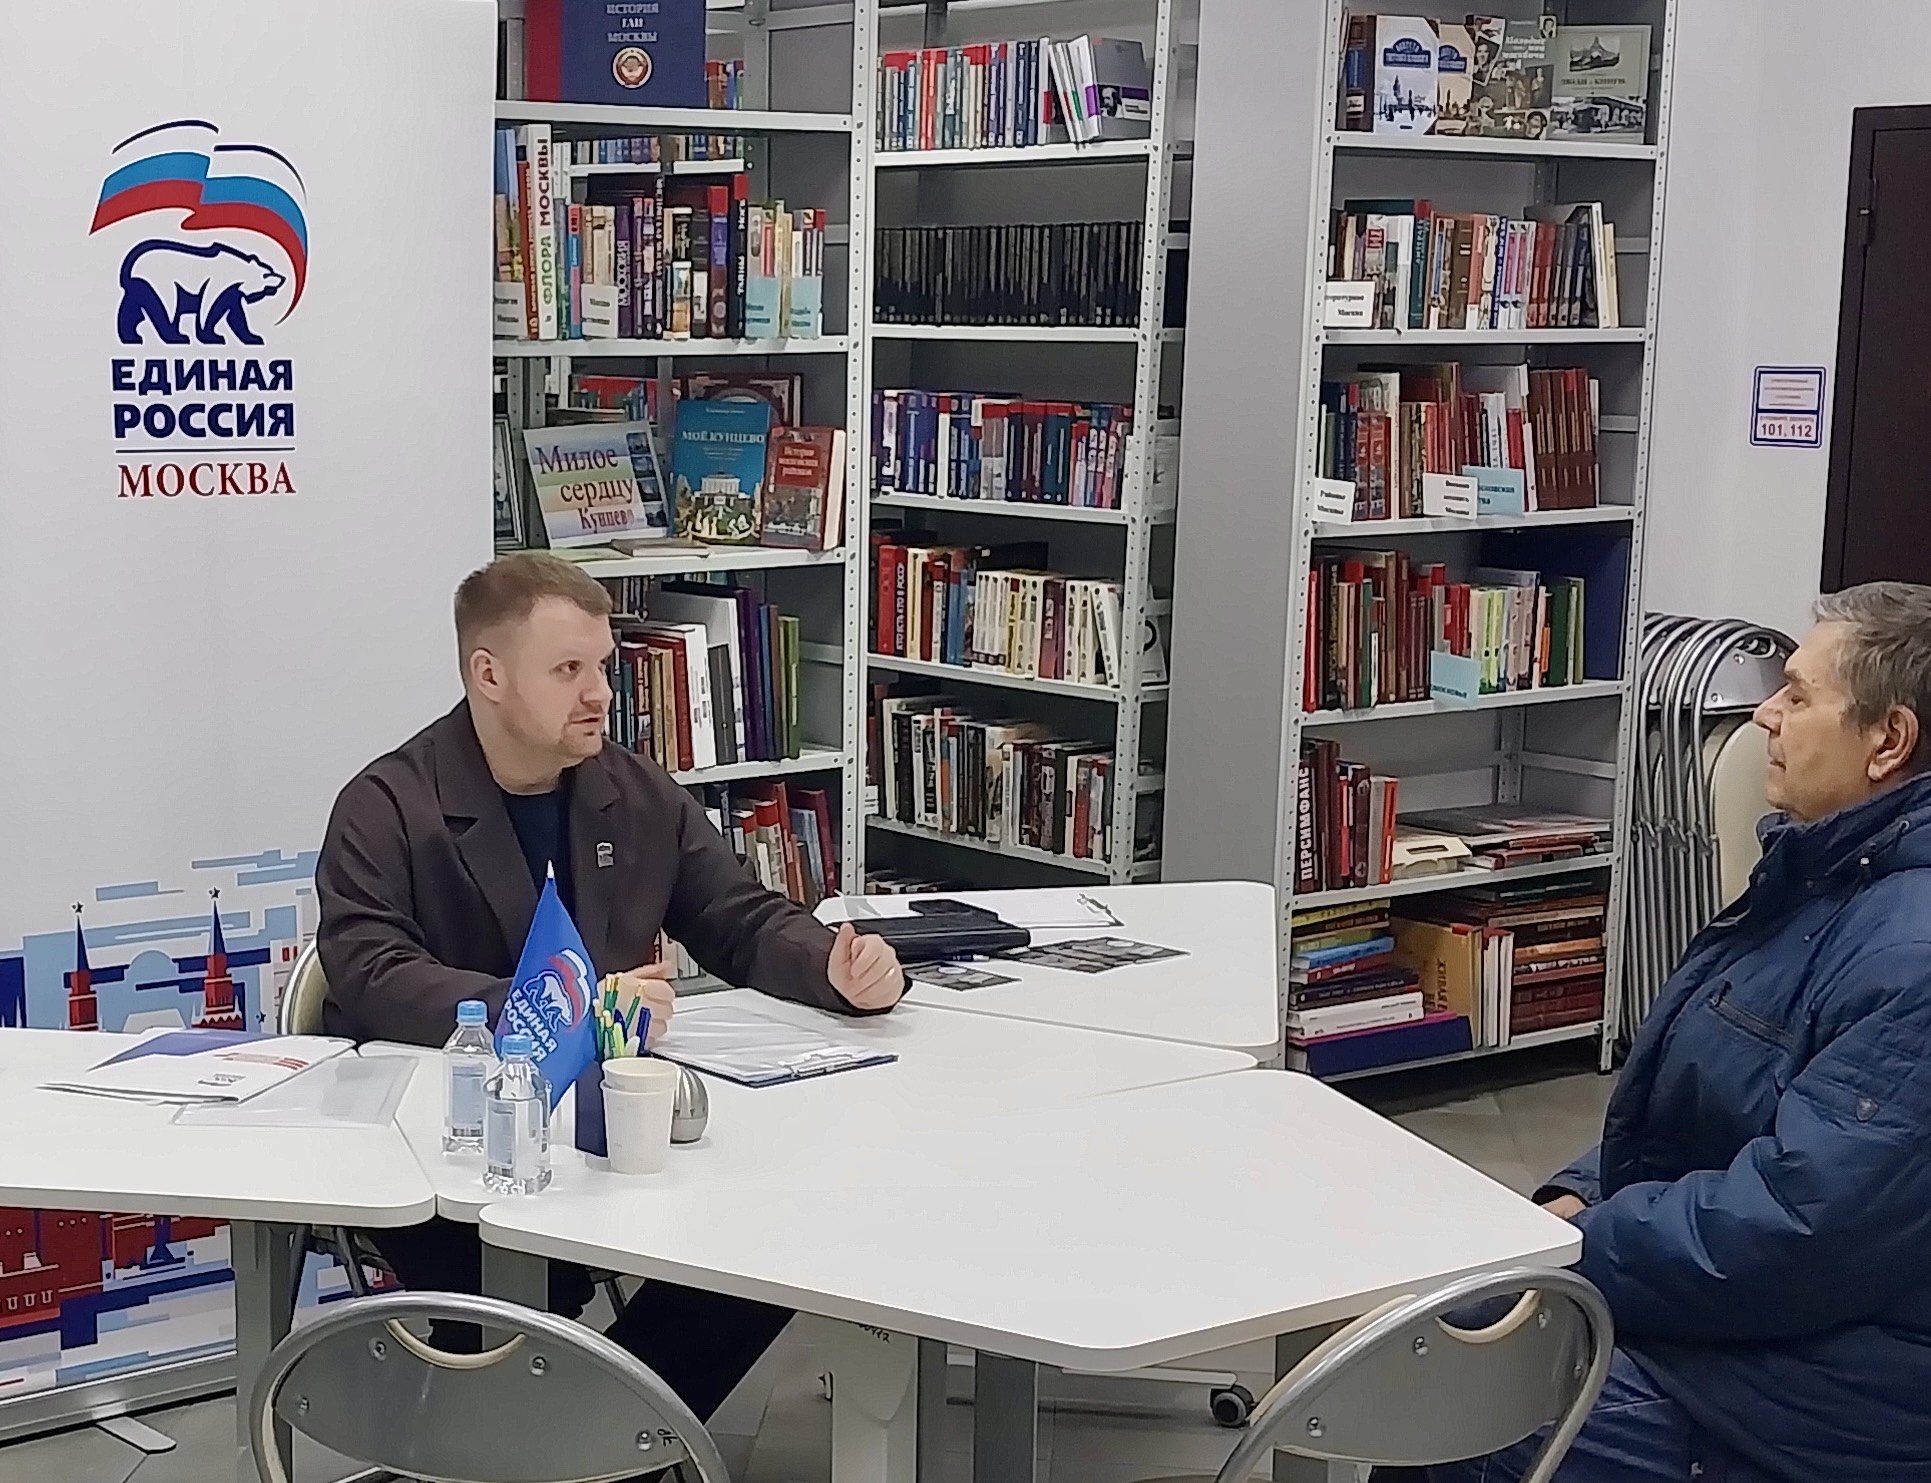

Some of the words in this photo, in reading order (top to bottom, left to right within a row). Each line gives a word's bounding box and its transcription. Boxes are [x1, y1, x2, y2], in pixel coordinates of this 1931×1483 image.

[537, 138, 550, 227] МОСКВЫ
[541, 235, 554, 305] ФЛОРА
[112, 359, 293, 395] ЕДИНАЯ
[114, 403, 294, 438] РОССИЯ
[535, 445, 618, 475] Милое
[118, 462, 296, 497] МОСКВА
[560, 479, 634, 507] сердцу
[1298, 767, 1313, 881] ПЕРСИМФАНС
[511, 988, 558, 1053] ЕДИНАЯ
